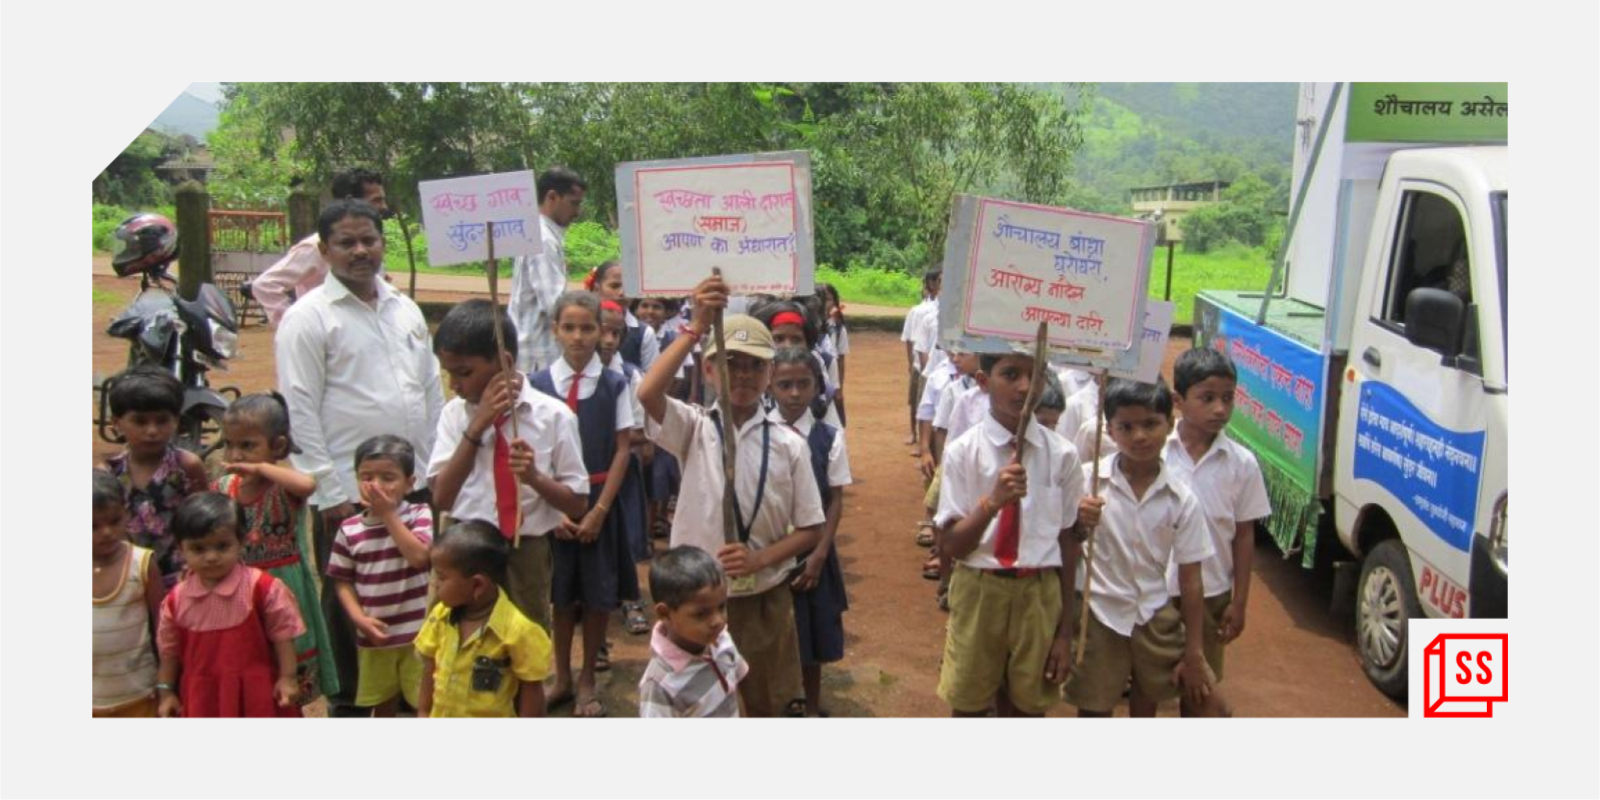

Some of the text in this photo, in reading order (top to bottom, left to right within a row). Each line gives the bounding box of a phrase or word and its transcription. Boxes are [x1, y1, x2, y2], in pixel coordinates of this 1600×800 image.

[1374, 93, 1453, 116] शौचालय
[653, 189, 715, 213] स्वच्छता
[722, 188, 757, 211] आली
[692, 215, 747, 233] (समाज)
[993, 213, 1105, 258] शौचालय बांधा
[661, 231, 706, 251] आपण
[710, 236, 728, 254] का
[984, 263, 1044, 298] आरोग्य
[1021, 305, 1071, 328] आपल्या
[1419, 566, 1467, 618] PLUS
